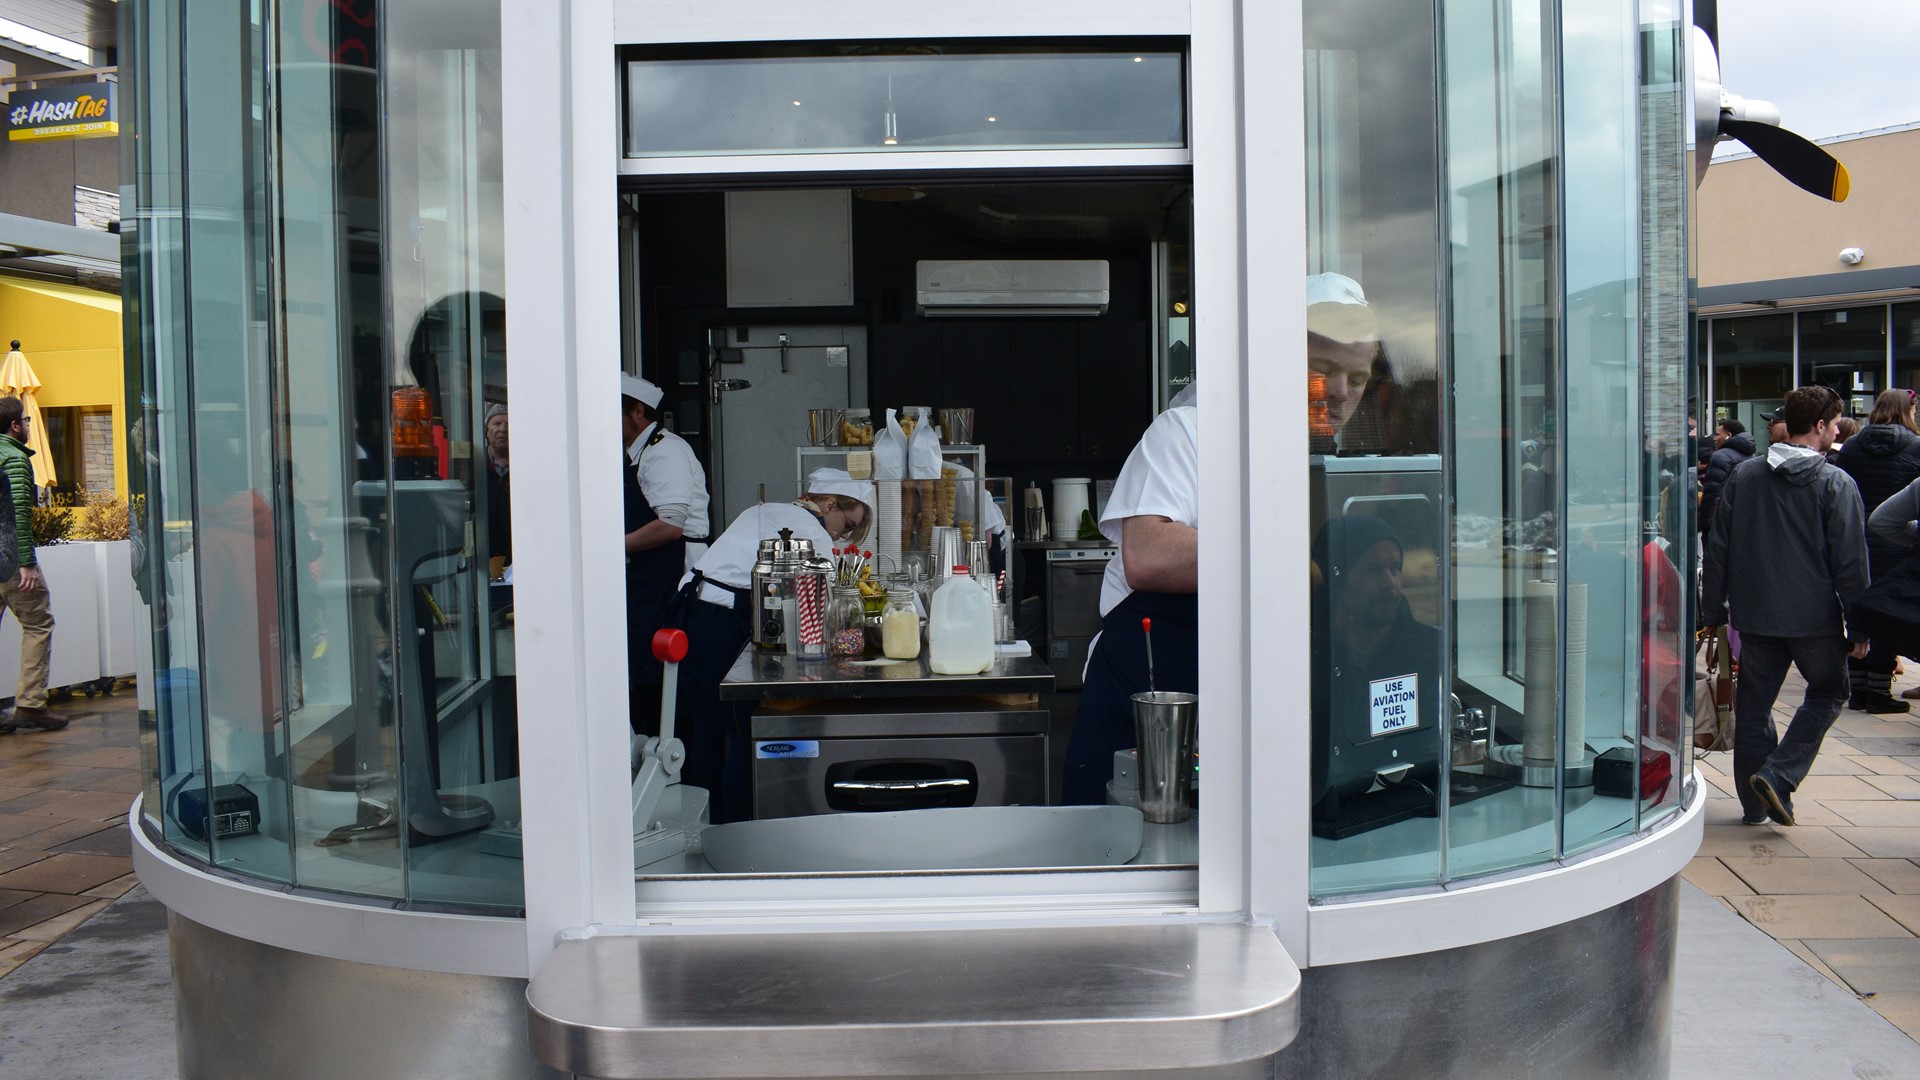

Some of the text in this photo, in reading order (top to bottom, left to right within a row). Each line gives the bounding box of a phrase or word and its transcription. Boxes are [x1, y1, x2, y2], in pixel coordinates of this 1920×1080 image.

[34, 122, 107, 136] BREAKFAST JOINT
[1385, 681, 1403, 693] USE
[1373, 690, 1415, 707] AVIATION
[1383, 705, 1406, 717] FUEL
[1383, 716, 1406, 729] ONLY
